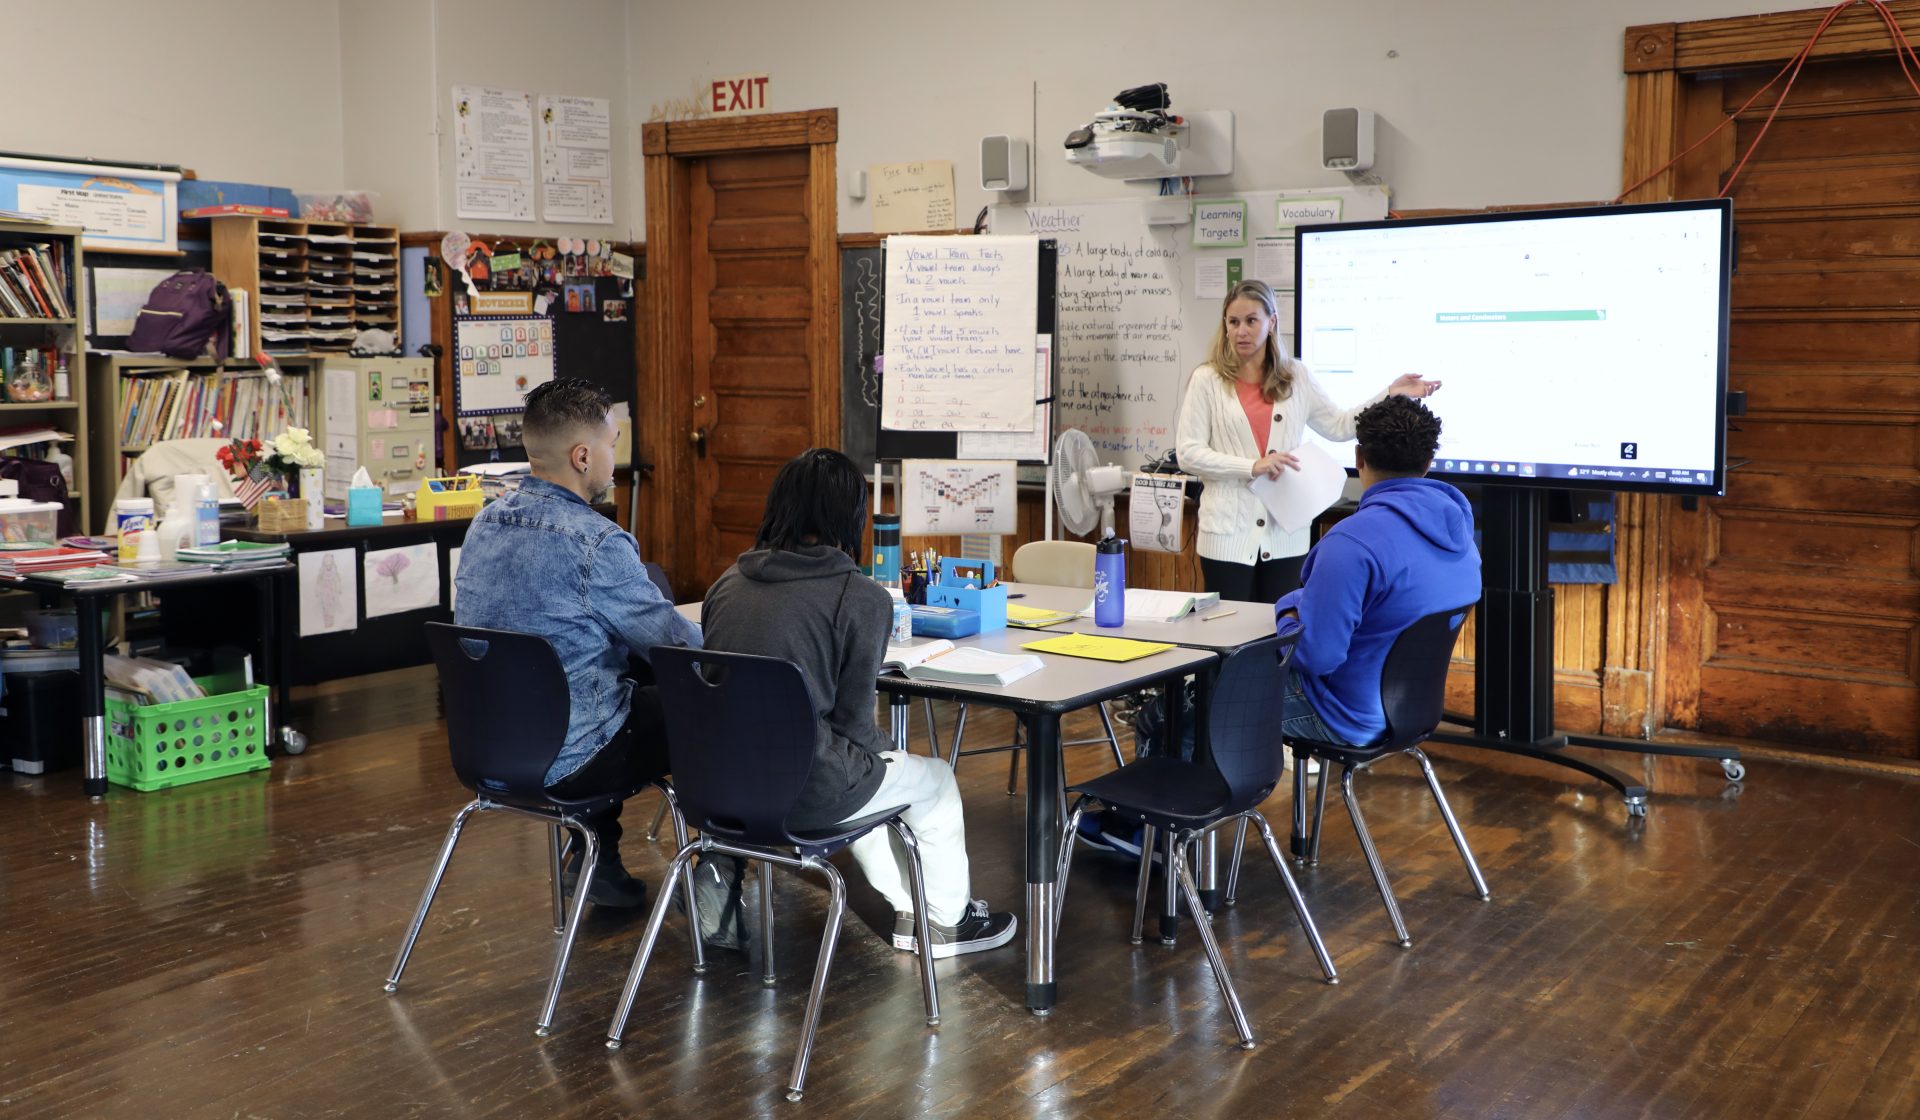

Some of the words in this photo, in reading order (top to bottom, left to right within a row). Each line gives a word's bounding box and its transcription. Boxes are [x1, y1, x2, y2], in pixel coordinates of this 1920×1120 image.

[711, 77, 769, 112] EXIT
[907, 162, 925, 174] Exit
[1025, 208, 1084, 228] Weather
[1200, 210, 1242, 221] Learning
[1282, 206, 1336, 220] Vocabulary
[1200, 228, 1240, 240] Targets
[905, 248, 939, 260] Vowel
[943, 247, 970, 260] Team
[979, 248, 1004, 261] Facts
[1076, 243, 1083, 256] A
[1087, 242, 1107, 261] large
[1110, 241, 1133, 266] body
[916, 263, 938, 272] vowel
[944, 263, 966, 272] team
[972, 263, 1001, 276] always
[1064, 264, 1072, 278] A
[1073, 264, 1095, 284] large
[1099, 264, 1120, 287] body
[906, 274, 921, 285] has
[939, 275, 967, 286] vowels
[922, 294, 945, 304] vowel
[951, 292, 972, 304] team
[979, 294, 1001, 308] only
[1081, 286, 1123, 304] separating
[1125, 286, 1137, 296] air
[1142, 286, 1172, 296] masses
[479, 298, 526, 308] NOVEMBER
[924, 306, 947, 317] vowel
[940, 324, 953, 335] the
[969, 325, 1000, 336] vowels
[1082, 319, 1114, 330] natural
[1118, 317, 1158, 332] movement
[900, 345, 913, 355] The
[937, 346, 960, 355] vowel
[1004, 345, 1024, 355] have
[1103, 349, 1116, 362] the
[1119, 348, 1161, 368] atmosphere
[899, 363, 921, 373] Each
[953, 363, 970, 374] has
[983, 363, 1014, 375] certain
[1068, 366, 1091, 378] drops
[1090, 382, 1132, 406] atmosphere
[1076, 400, 1092, 411] and
[123, 517, 145, 531] Lysol
